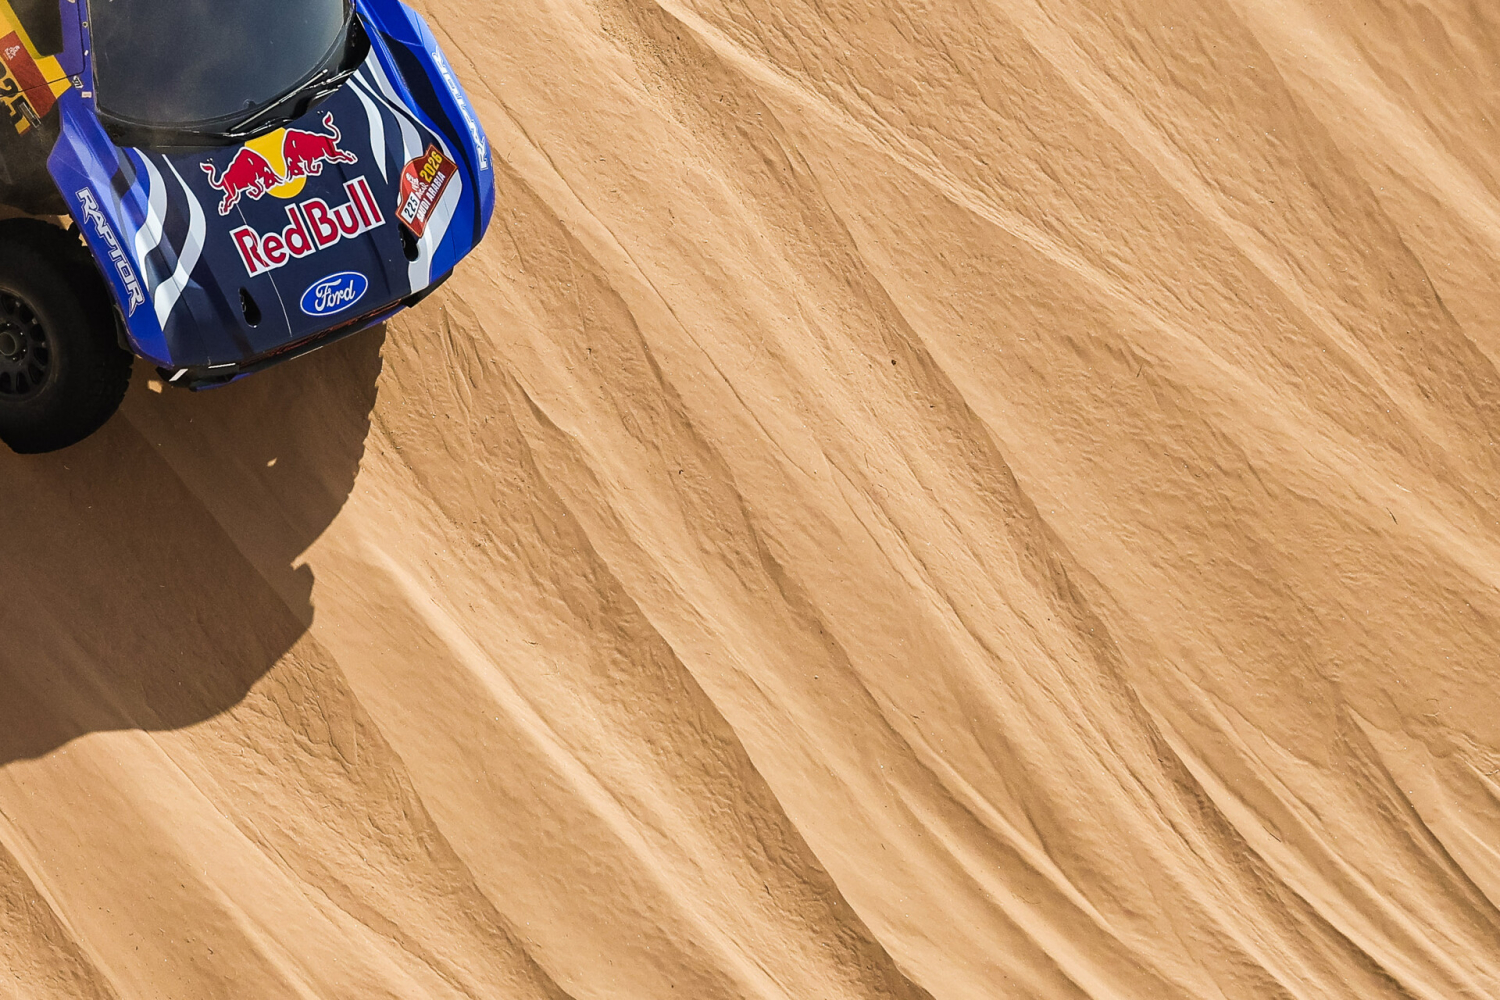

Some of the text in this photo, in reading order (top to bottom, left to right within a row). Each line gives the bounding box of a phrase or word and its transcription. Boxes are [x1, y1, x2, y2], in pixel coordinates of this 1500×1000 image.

[419, 151, 442, 183] 2026
[425, 171, 446, 202] ARABIA
[404, 196, 418, 218] 225
[75, 187, 145, 317] RAPTOR
[315, 279, 356, 311] Ford
